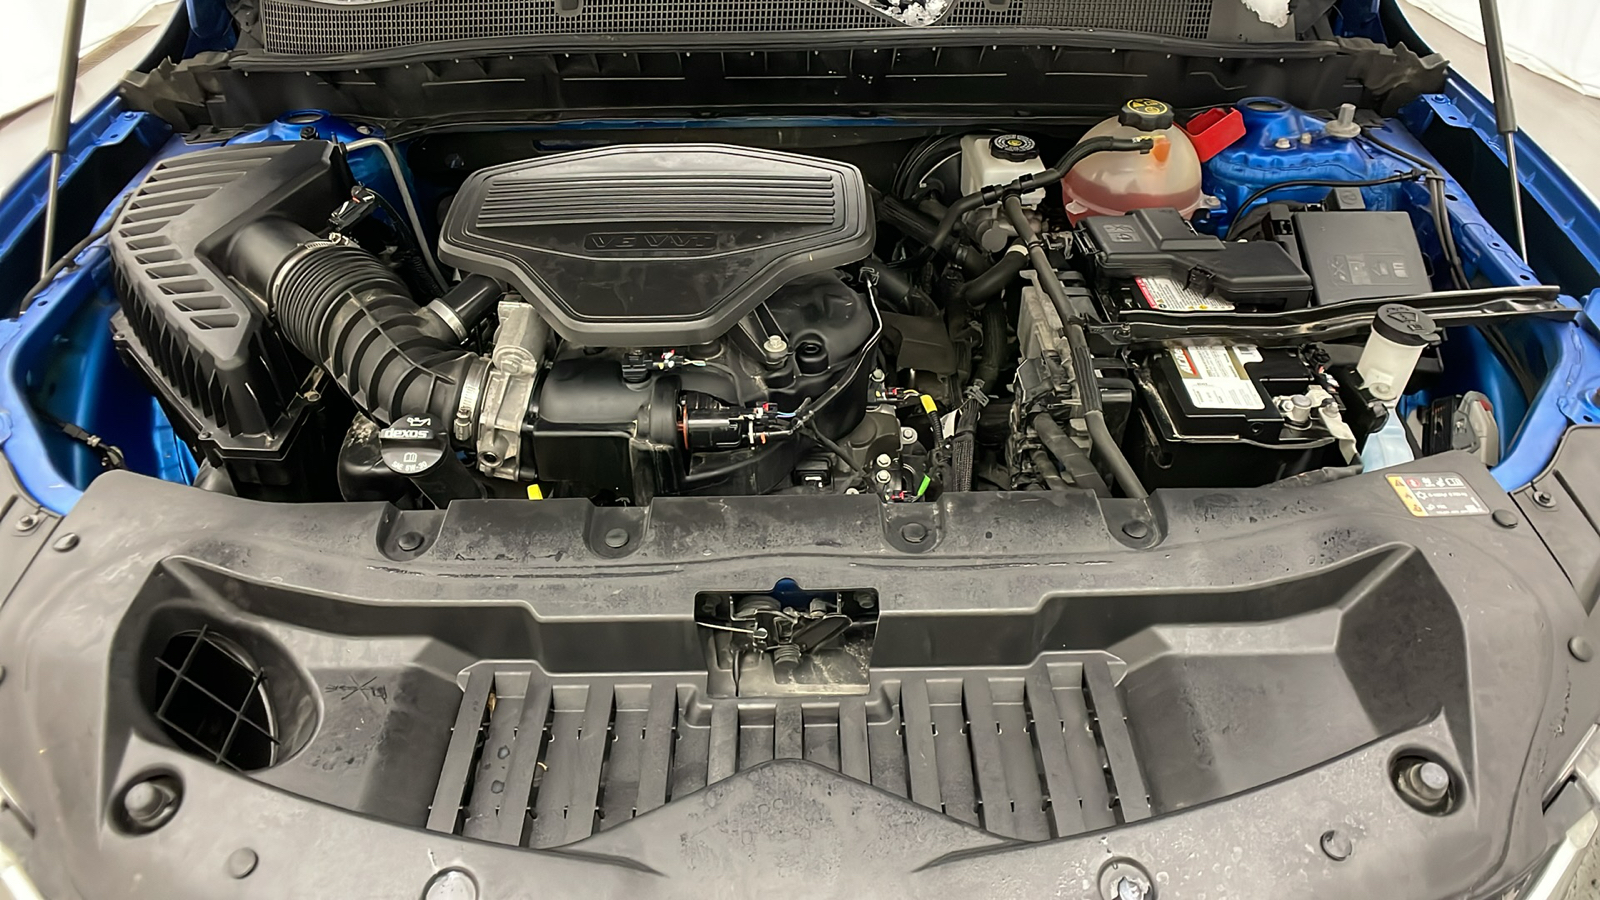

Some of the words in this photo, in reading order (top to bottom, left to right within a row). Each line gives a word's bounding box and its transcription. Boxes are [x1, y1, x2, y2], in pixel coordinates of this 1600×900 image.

[643, 234, 713, 247] VVT
[384, 427, 430, 439] dexos
[391, 460, 404, 471] SAE
